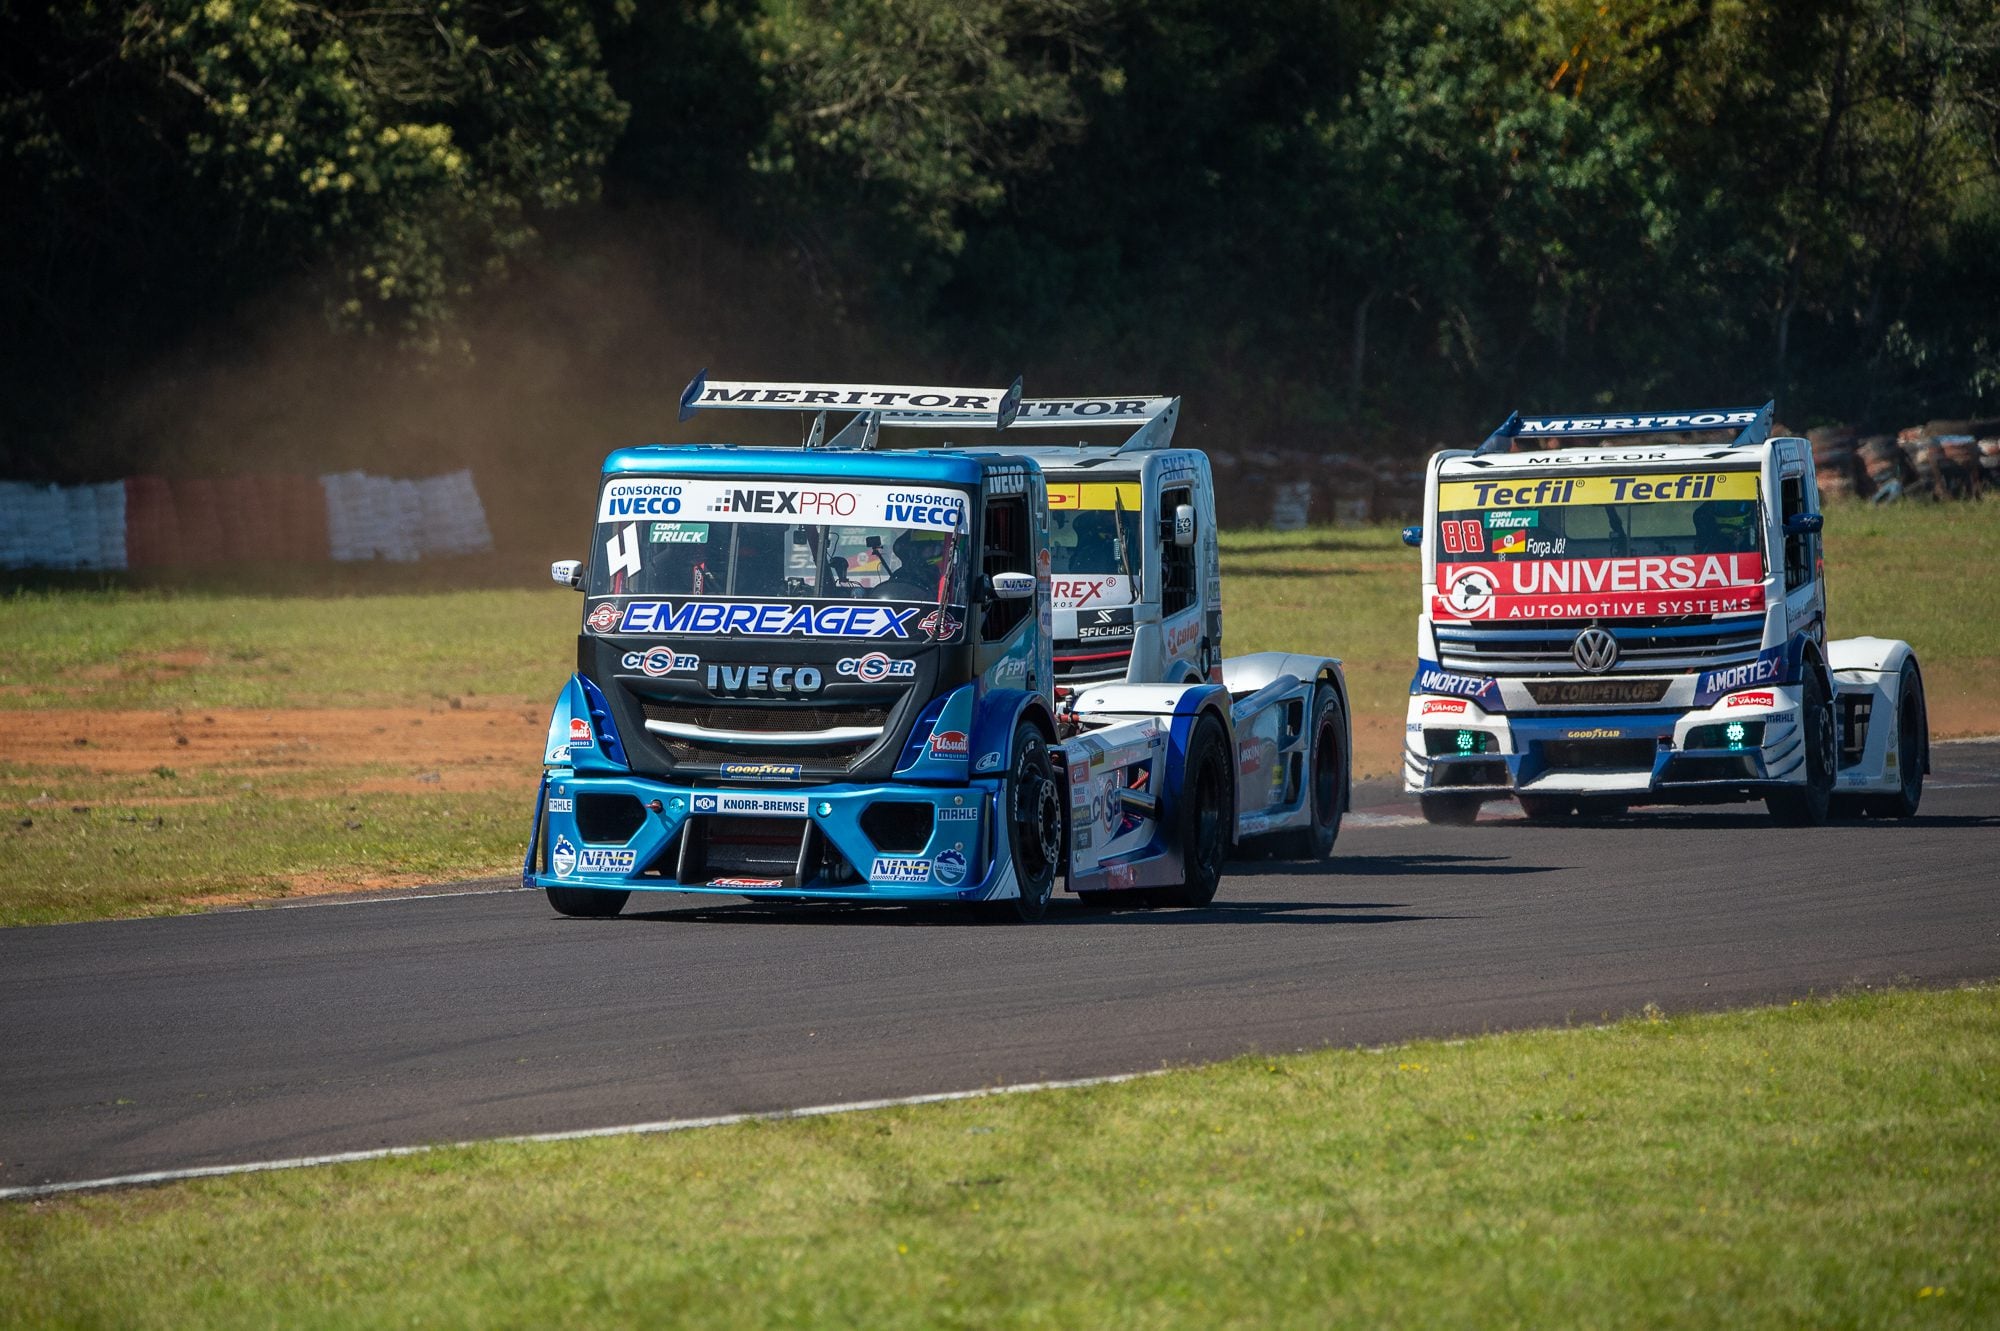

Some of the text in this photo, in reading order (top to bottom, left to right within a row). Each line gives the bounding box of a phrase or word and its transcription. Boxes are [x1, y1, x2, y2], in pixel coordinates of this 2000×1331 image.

[704, 388, 990, 409] MERITOR
[1521, 412, 1757, 432] MERITOR
[1528, 453, 1666, 463] METEOR
[988, 465, 1025, 493] IVECO
[610, 485, 682, 496] CONSÓRCIO
[887, 492, 964, 507] CONSÓRCIO
[608, 497, 681, 515] IVECO
[731, 489, 857, 516] NEXPRO
[885, 504, 963, 527] IVECO
[1489, 518, 1531, 528] TRUCK
[652, 531, 705, 543] TRUCK
[1441, 519, 1485, 553] 88
[605, 521, 641, 578] 4
[1527, 538, 1566, 557] Força Jô!
[1513, 556, 1756, 594] UNIVERSAL
[1509, 598, 1751, 618] AUTOMOTIVE SYSTEMS
[620, 602, 920, 638] EMBREAGEX
[1079, 625, 1132, 637] SFICHIPS
[624, 652, 699, 670] CISER
[838, 658, 915, 675] CISER
[1006, 661, 1026, 676] FPT
[708, 665, 822, 693] IVECO
[1421, 670, 1496, 697] AMORTEX
[1706, 656, 1780, 694] AMORTEX
[1431, 704, 1464, 712] VAMOS
[1738, 696, 1772, 704] VAMOS
[1766, 714, 1795, 723] MAHLE
[1568, 728, 1620, 739] GOODYEAR
[726, 764, 795, 775] GOODYEAR
[724, 799, 805, 812] KNORR-BREMSE
[938, 808, 977, 820] MAHLE
